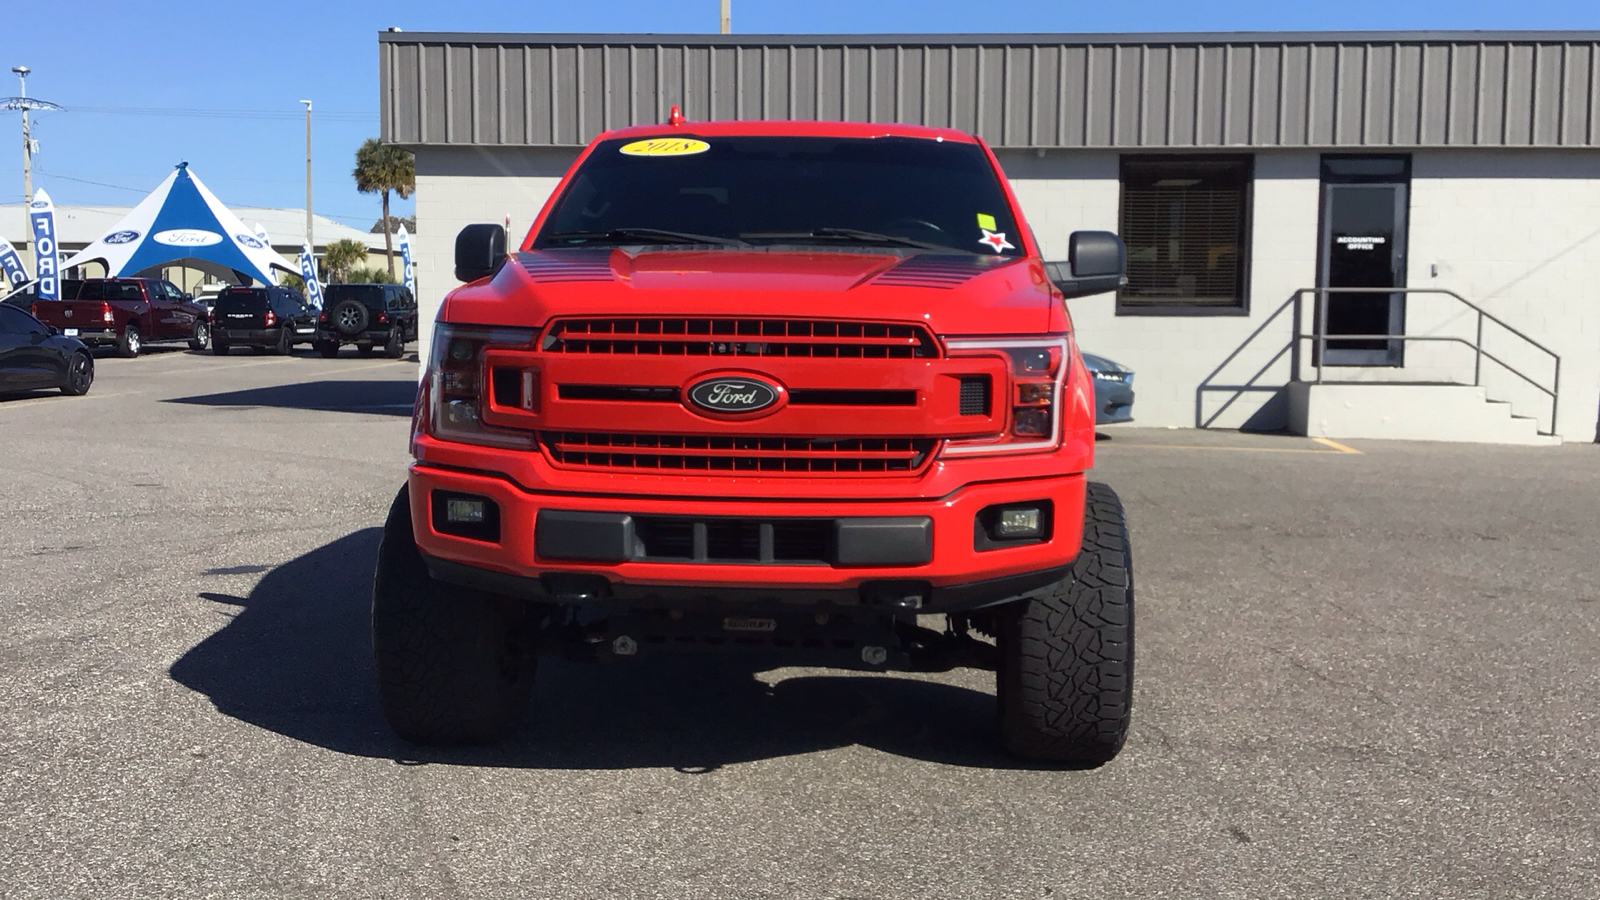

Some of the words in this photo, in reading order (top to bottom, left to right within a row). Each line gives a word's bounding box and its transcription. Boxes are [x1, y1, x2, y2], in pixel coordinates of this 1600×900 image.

[632, 141, 697, 152] 2018
[168, 232, 207, 243] Ford
[708, 383, 758, 404] Ford
